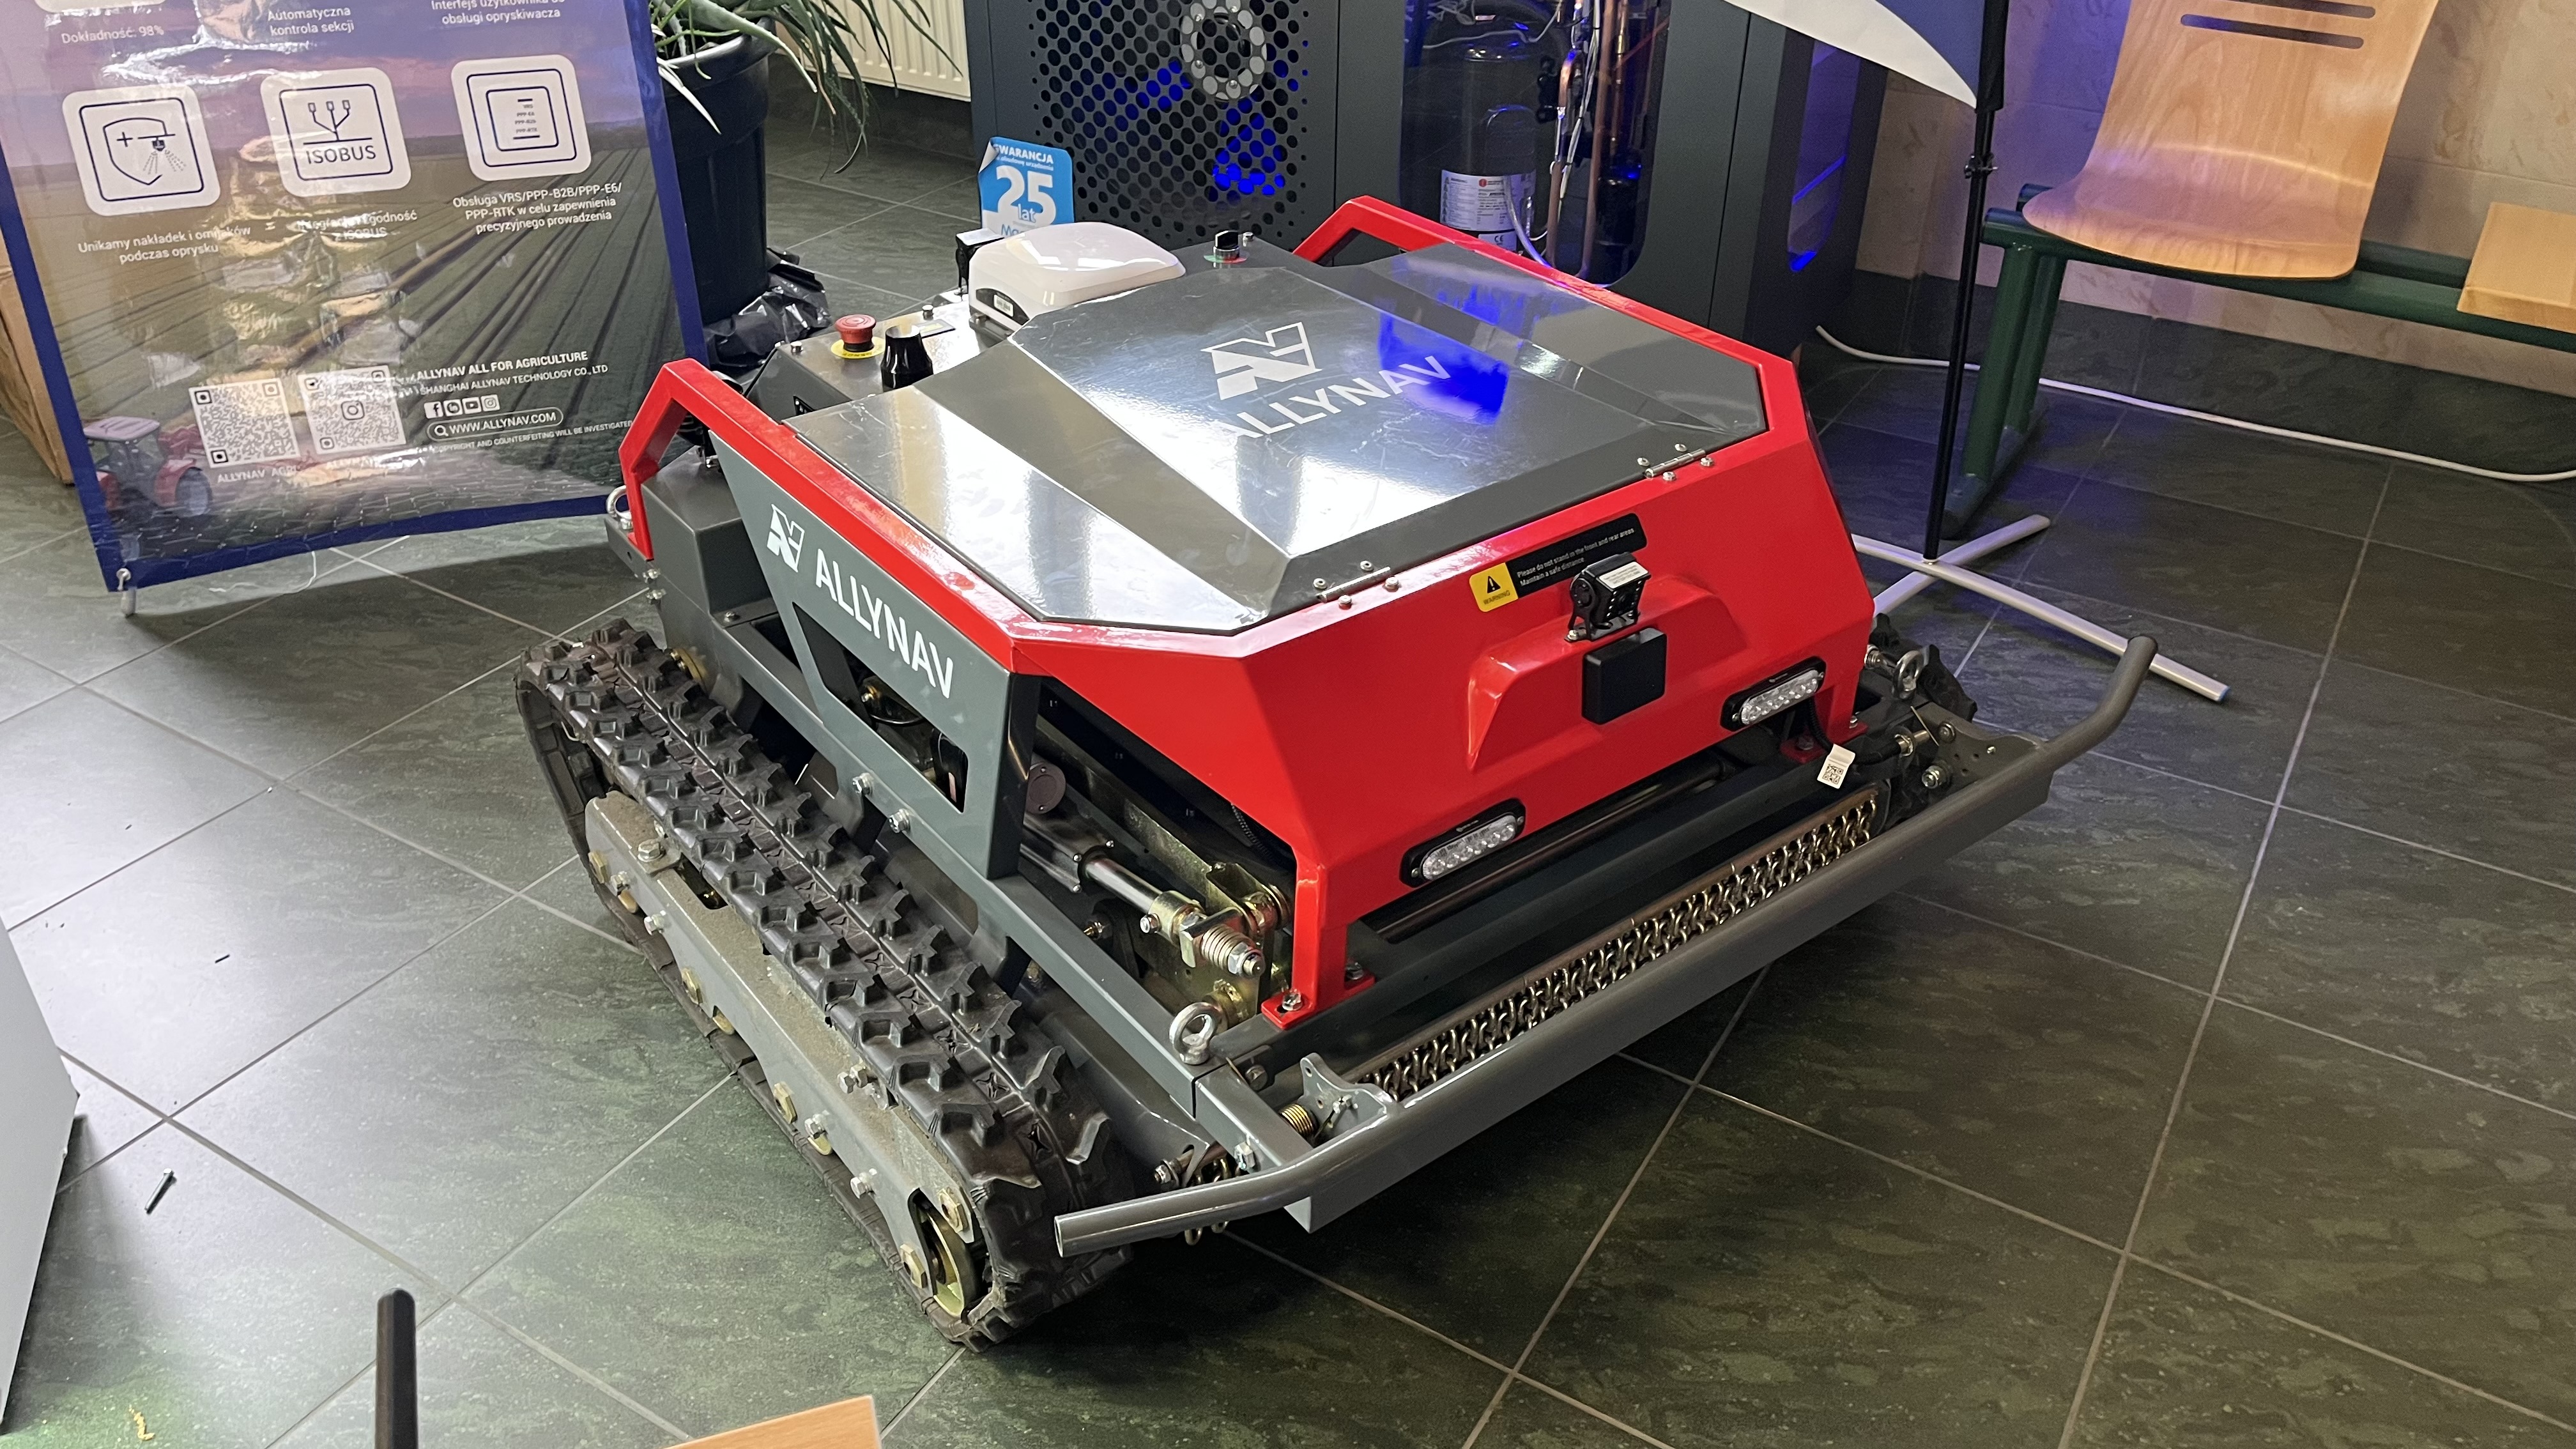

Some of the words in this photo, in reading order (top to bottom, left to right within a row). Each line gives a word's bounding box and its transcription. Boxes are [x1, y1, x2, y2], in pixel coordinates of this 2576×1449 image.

[268, 7, 351, 21] Automatyczna
[441, 12, 484, 25] obsługi
[486, 8, 561, 23] opryskiwacza
[61, 27, 137, 43] Dokładność:
[139, 25, 164, 36] 98%
[270, 22, 319, 36] kontrola
[321, 20, 355, 33] sekcji
[305, 145, 376, 164] ISOBUS
[452, 195, 498, 208] Obsługa
[499, 182, 622, 204] VRS/PPP-B2B/PPP-E6/
[996, 165, 1056, 226] 25
[465, 206, 516, 220] PPP-RTK
[517, 206, 526, 215] w
[528, 203, 551, 215] celu
[553, 196, 617, 213] zapewnienia
[1018, 203, 1036, 223] lat
[476, 218, 545, 234] precyzyjnego
[547, 210, 612, 227] prowadzenia
[78, 240, 130, 253] Unikamy
[133, 231, 187, 247] nakładek
[188, 230, 193, 241] i
[119, 248, 169, 264] podczas
[171, 242, 219, 257] oprysku
[417, 366, 466, 381] ALLYNAV
[468, 362, 489, 374] ALL
[491, 360, 514, 372] FOR
[516, 351, 588, 369] AGRICULTURE
[420, 383, 470, 395] SHANGHAI
[471, 378, 511, 390] ALLYNAV
[512, 370, 572, 385] TECHNOLOGY
[449, 412, 556, 434] WWW.ALLYNAV.COM
[493, 431, 555, 446] COUNTERFEITING
[556, 429, 572, 437] WILL
[217, 469, 264, 483] ALLYNAV
[1517, 567, 1536, 578] Please
[1544, 559, 1554, 567] not
[1554, 553, 1570, 564] stand
[1598, 537, 1609, 546] and
[1609, 533, 1620, 542] rear
[1620, 528, 1635, 537] areas
[1520, 572, 1545, 586] Maintain
[1549, 566, 1561, 576] safe
[1561, 557, 1585, 571] distance
[815, 548, 954, 699] ALLYNAV
